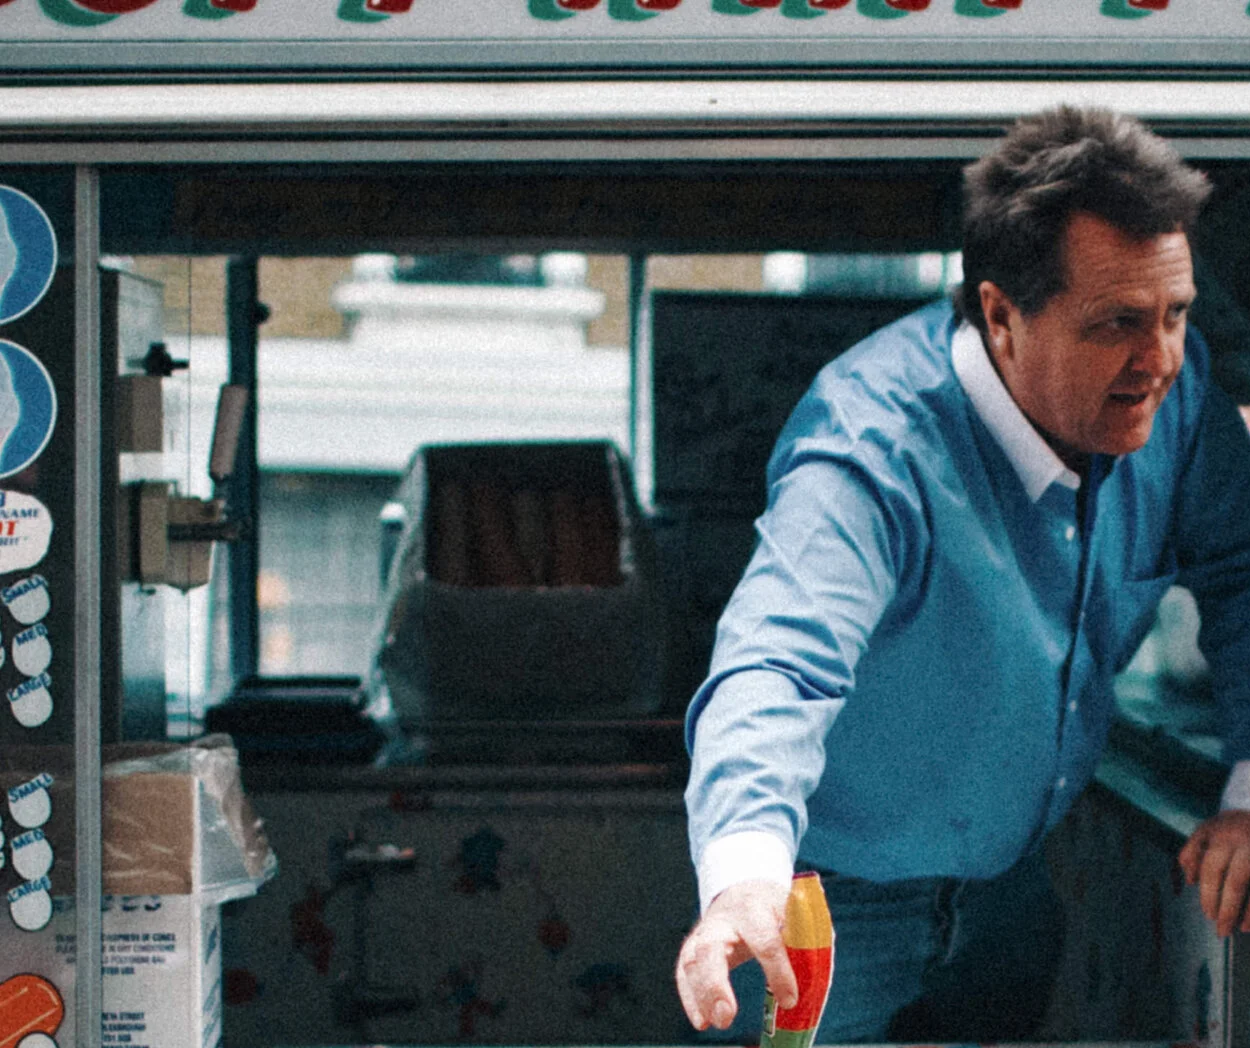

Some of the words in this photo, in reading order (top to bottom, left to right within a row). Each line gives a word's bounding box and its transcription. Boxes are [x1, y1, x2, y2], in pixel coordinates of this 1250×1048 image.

[2, 574, 47, 603] SMALL
[15, 623, 48, 646] MED
[8, 671, 51, 701] LARGE
[8, 772, 53, 802] SMALL
[12, 828, 45, 850] MED
[8, 875, 52, 902] LARGE
